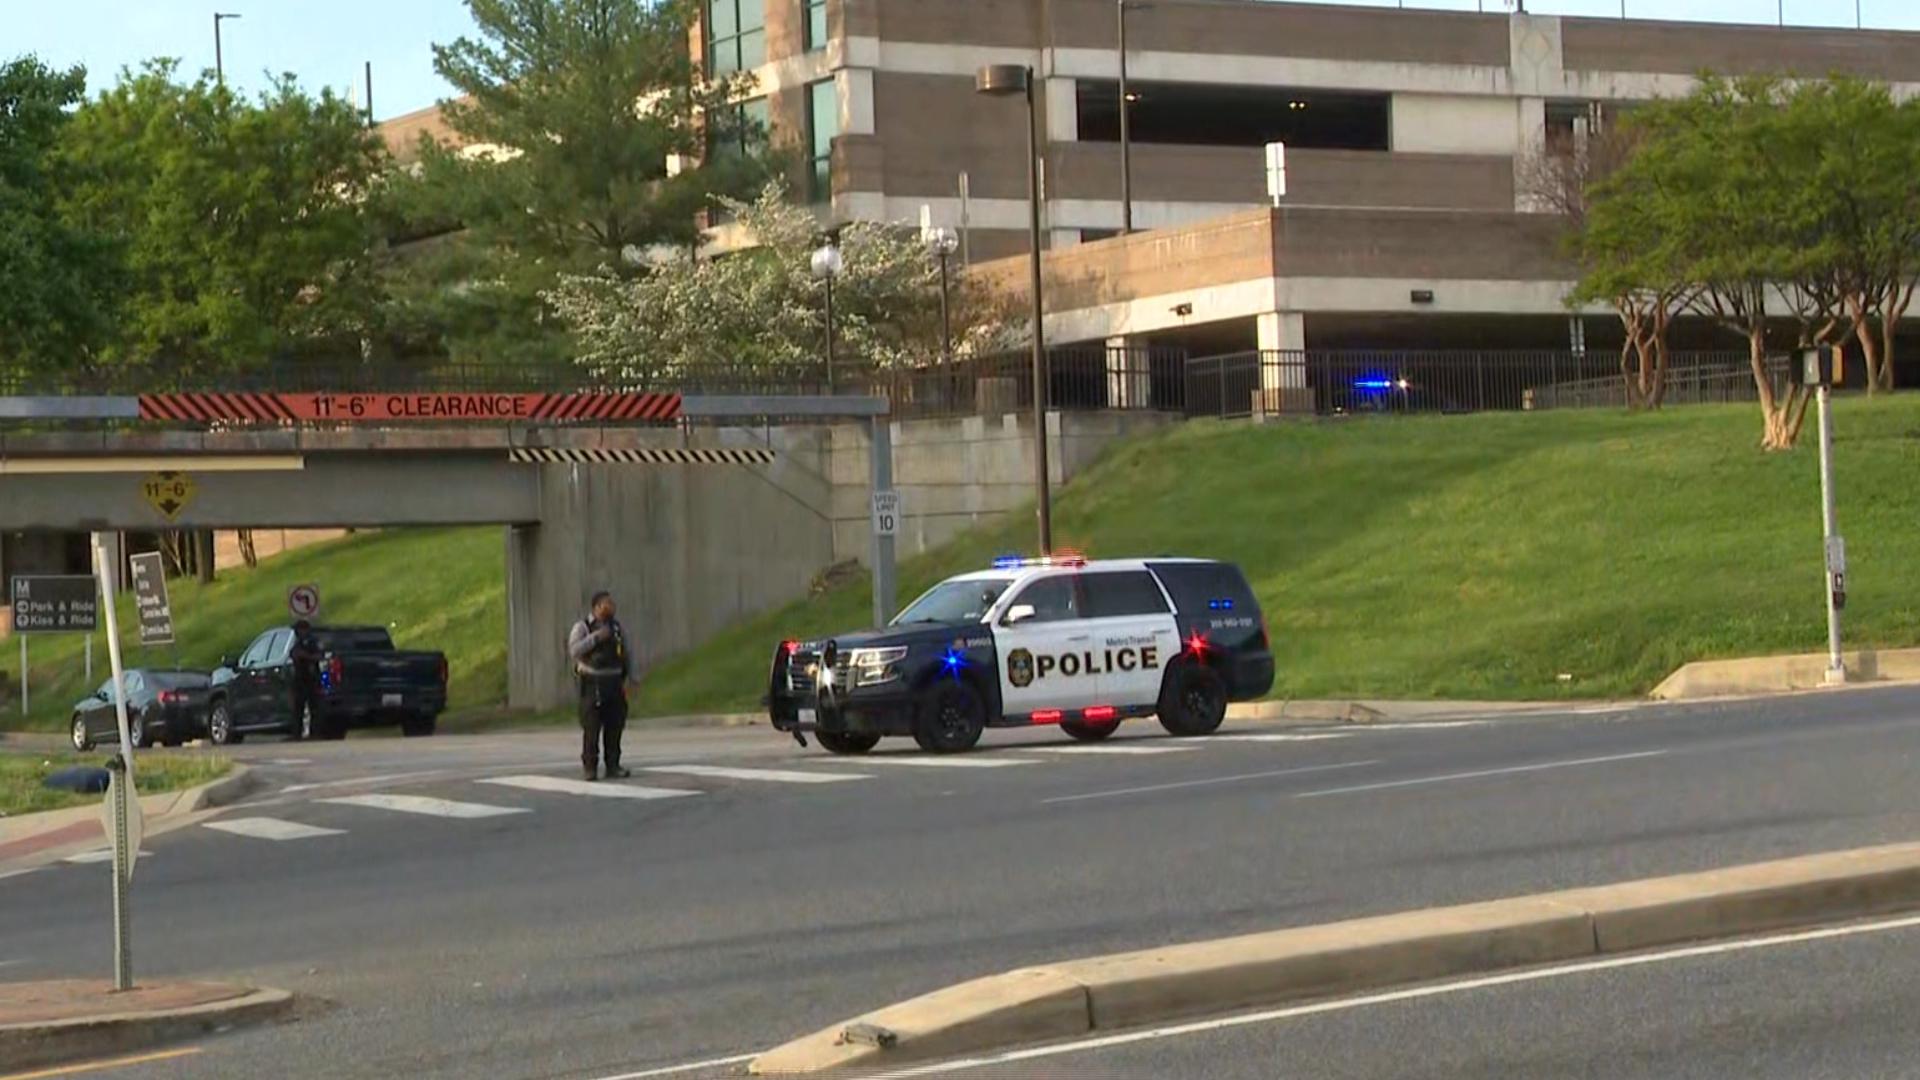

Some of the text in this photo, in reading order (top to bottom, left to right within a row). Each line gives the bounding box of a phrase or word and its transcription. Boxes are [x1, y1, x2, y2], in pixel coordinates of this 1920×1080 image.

[386, 396, 527, 416] CLEARANCE
[874, 494, 898, 503] SPEED
[876, 503, 895, 512] LIMIT
[879, 514, 894, 531] 10
[16, 580, 30, 596] M
[30, 601, 54, 612] Park
[71, 601, 95, 612] Ride
[30, 614, 53, 626] Kiss
[70, 613, 94, 625] Ride
[1036, 646, 1159, 678] POLICE
